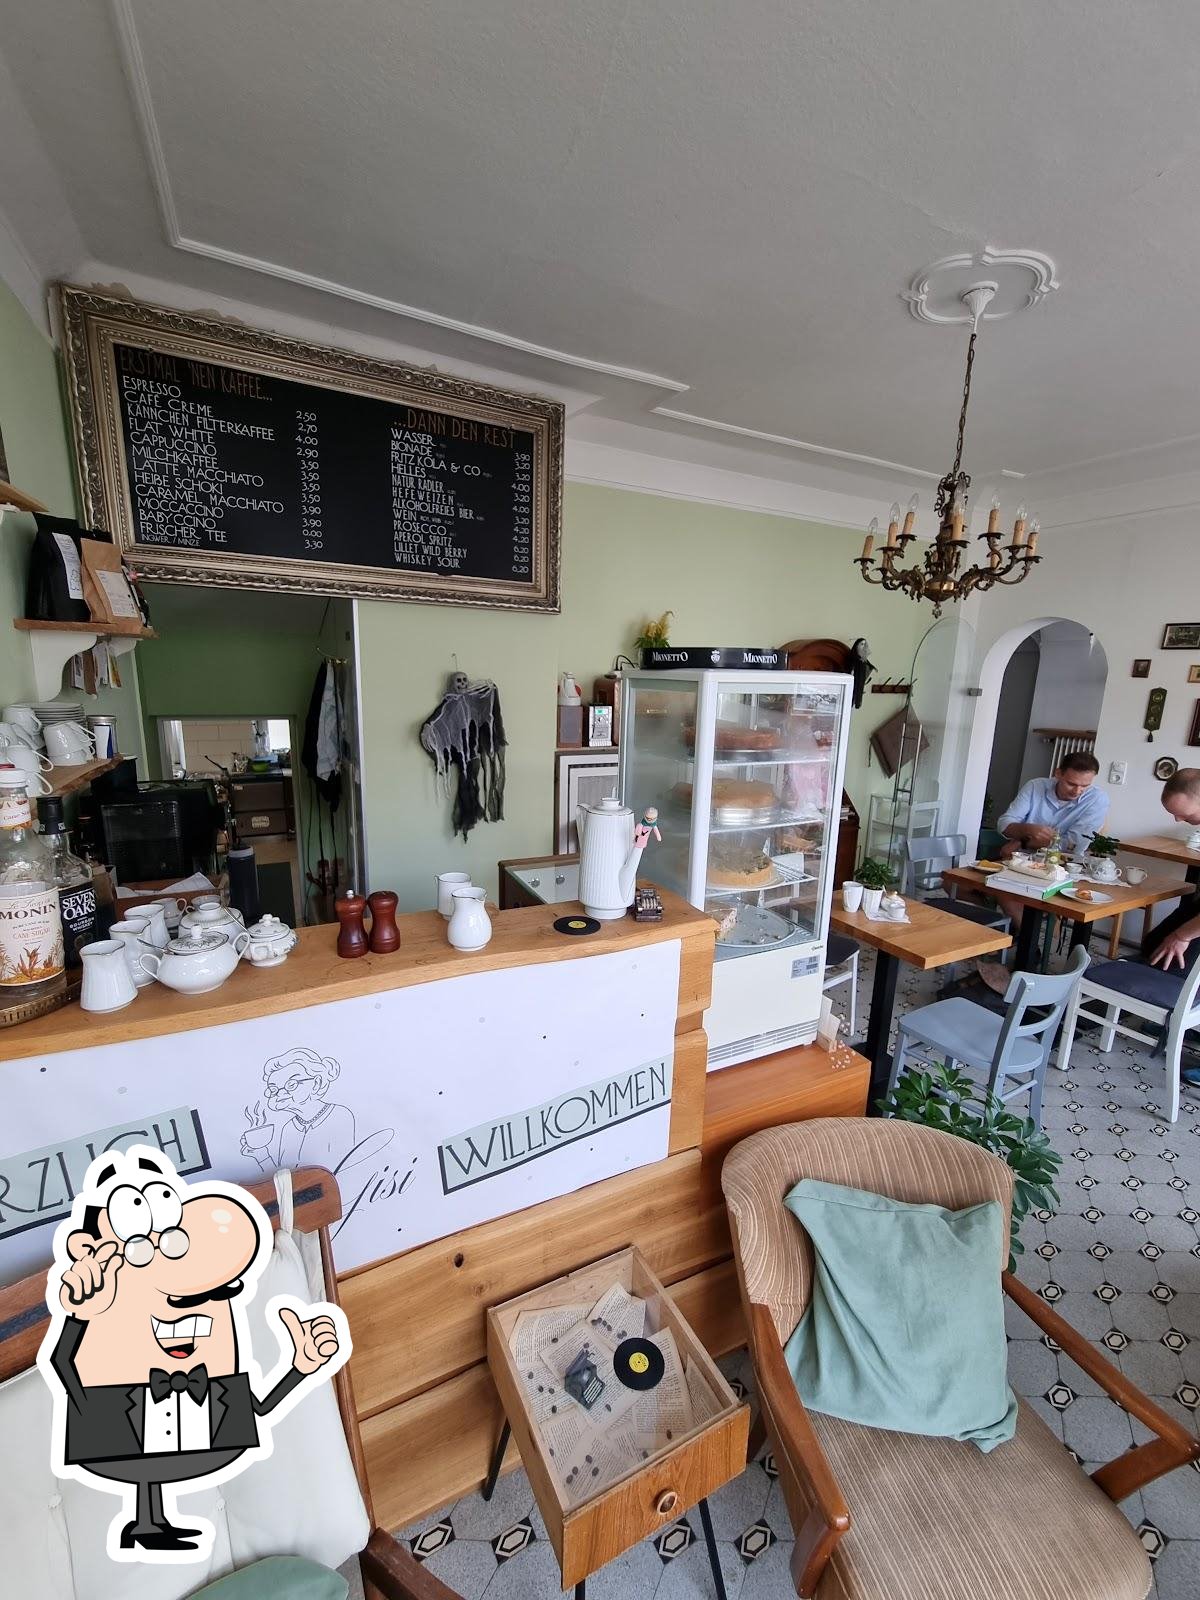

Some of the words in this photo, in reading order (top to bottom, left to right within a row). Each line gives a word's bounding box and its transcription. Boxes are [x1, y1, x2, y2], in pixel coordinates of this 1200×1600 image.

[122, 375, 181, 398] ESPRESSO
[168, 399, 214, 418] CREME
[296, 410, 317, 422] 2.50
[127, 403, 189, 426] KÄNNCHEN
[196, 416, 275, 441] FILTERKAFFEE
[128, 417, 163, 435] FLAT
[169, 425, 215, 445] WHITE
[298, 423, 318, 435] 2.70
[295, 435, 318, 446] 4.00
[391, 427, 437, 447] WASSER
[452, 418, 478, 442] DEN
[484, 427, 518, 448] REST
[130, 432, 217, 457] CAPPUCCINO
[296, 447, 319, 459] 2.90
[391, 440, 433, 457] BIONADE
[131, 445, 219, 470] MILCHKAFFEE
[301, 459, 319, 471] 3.50
[391, 450, 415, 466] FRITZ
[417, 456, 447, 471] KOLA
[450, 462, 460, 473] &
[463, 464, 481, 477] CO
[132, 457, 180, 477] LATTE
[187, 466, 264, 487] MACCHIATO
[301, 471, 320, 482] 3.50
[391, 462, 427, 479] HELLES
[175, 477, 223, 495] SCHOKI
[301, 482, 320, 493] 3.50
[392, 474, 416, 489] NATUR
[418, 478, 445, 494] RADLER
[135, 484, 203, 505] CARAMEL
[209, 494, 284, 514] MACCHIATO
[301, 493, 321, 504] 3.50
[138, 497, 224, 519] MOCCACCINO
[301, 505, 321, 516] 3.90
[392, 498, 455, 517] ALKOHOLFREIES
[459, 508, 475, 520] BIER
[393, 509, 417, 522] WEIN
[302, 517, 322, 528] 3.90
[393, 520, 447, 536] PROSECCO
[140, 521, 202, 540] FRISCHER
[205, 529, 228, 543] TEE
[393, 531, 426, 545] APEROL
[429, 535, 453, 548] SPRITZ
[305, 539, 323, 550] 3.30
[394, 541, 418, 555] LILLET
[422, 544, 441, 557] WILD
[444, 547, 467, 559] BERRY
[394, 552, 432, 567] WHISKEY
[437, 557, 461, 569] SOUR
[743, 652, 778, 664] MIONETTO
[62, 889, 96, 909] SEVEN
[0, 902, 57, 920] MONIN
[63, 900, 96, 920] OAKS
[69, 916, 95, 929] BOURBON
[445, 1062, 667, 1176] WILLKOMMEN
